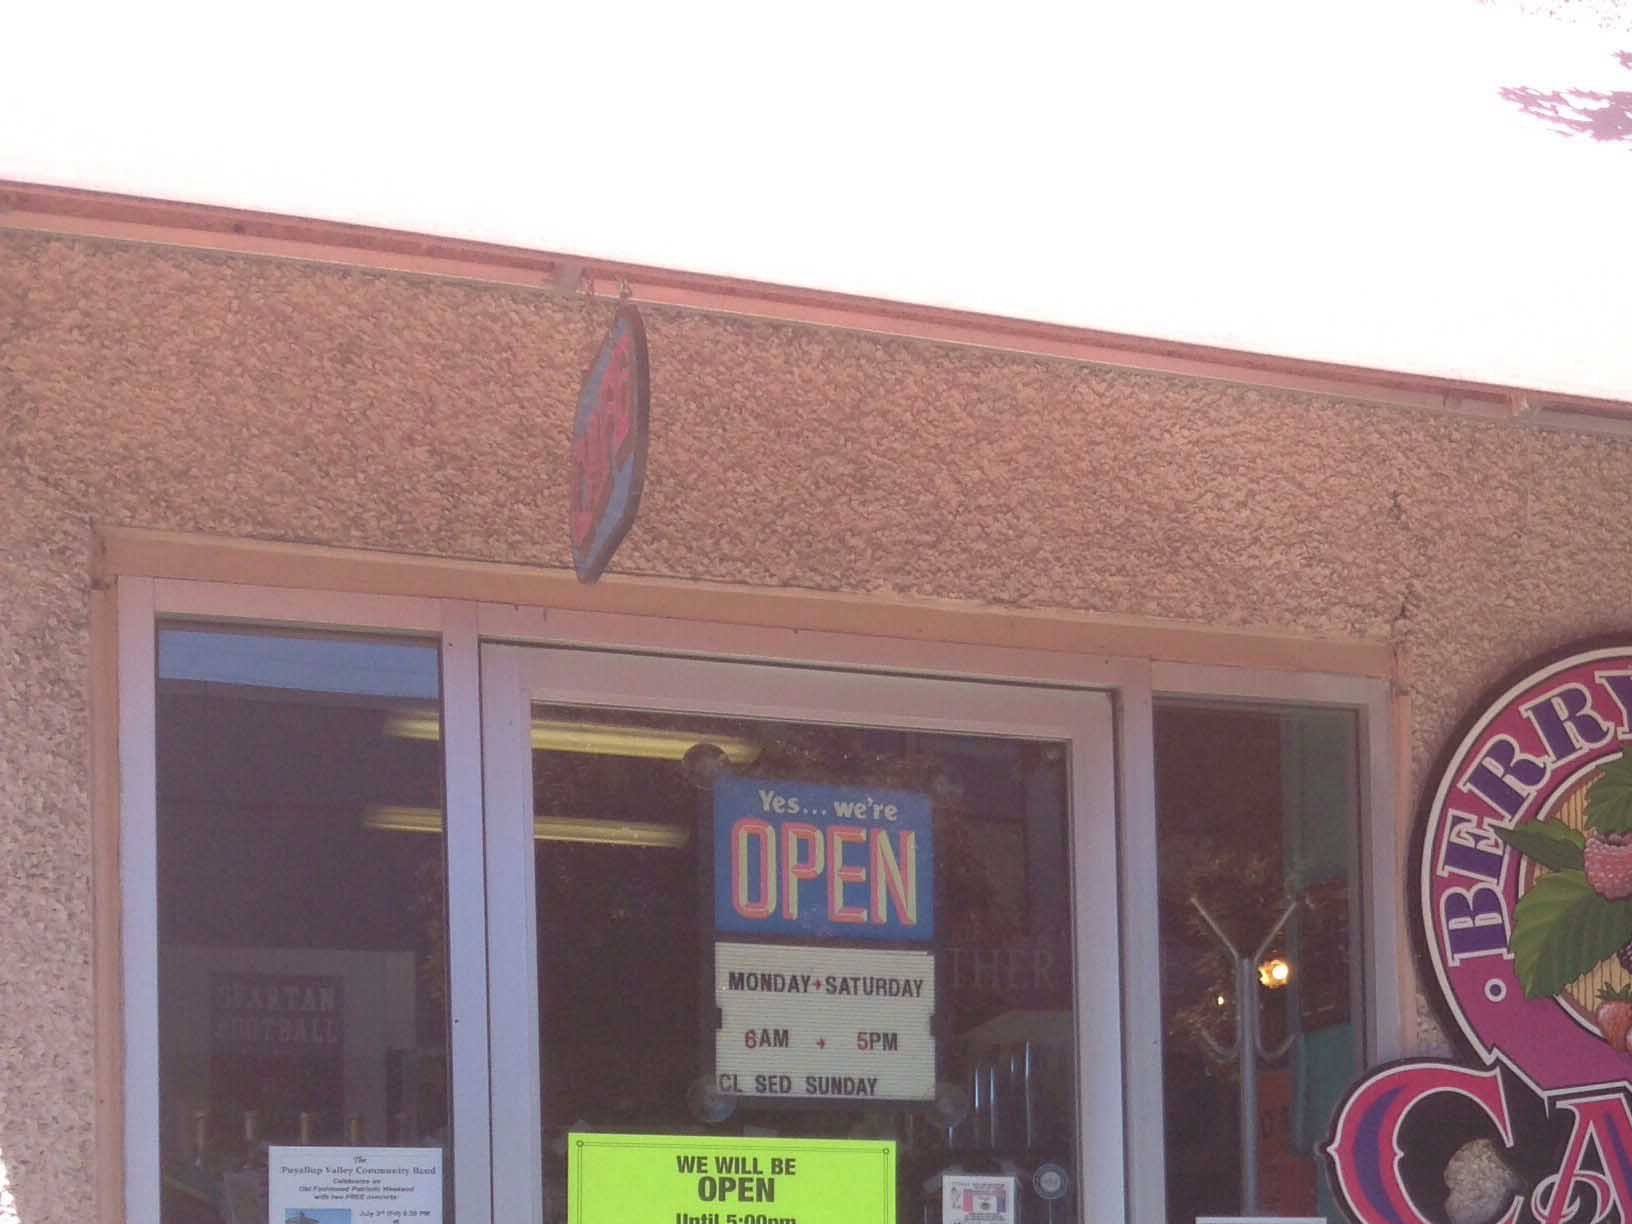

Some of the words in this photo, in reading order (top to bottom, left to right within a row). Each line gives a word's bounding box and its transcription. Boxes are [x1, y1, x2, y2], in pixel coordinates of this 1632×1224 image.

[758, 788, 828, 816] Yes...
[833, 797, 898, 821] we're
[731, 818, 918, 926] OPEN
[728, 972, 811, 993] MONDAY
[825, 976, 924, 998] SATURDAY
[745, 1029, 790, 1049] 6AM
[857, 1032, 899, 1051] 5PM
[805, 1076, 878, 1097] SUNDAY
[676, 1156, 708, 1173] WE
[714, 1156, 763, 1175] WILL
[771, 1158, 796, 1176] BE
[698, 1176, 775, 1203] OPEN
